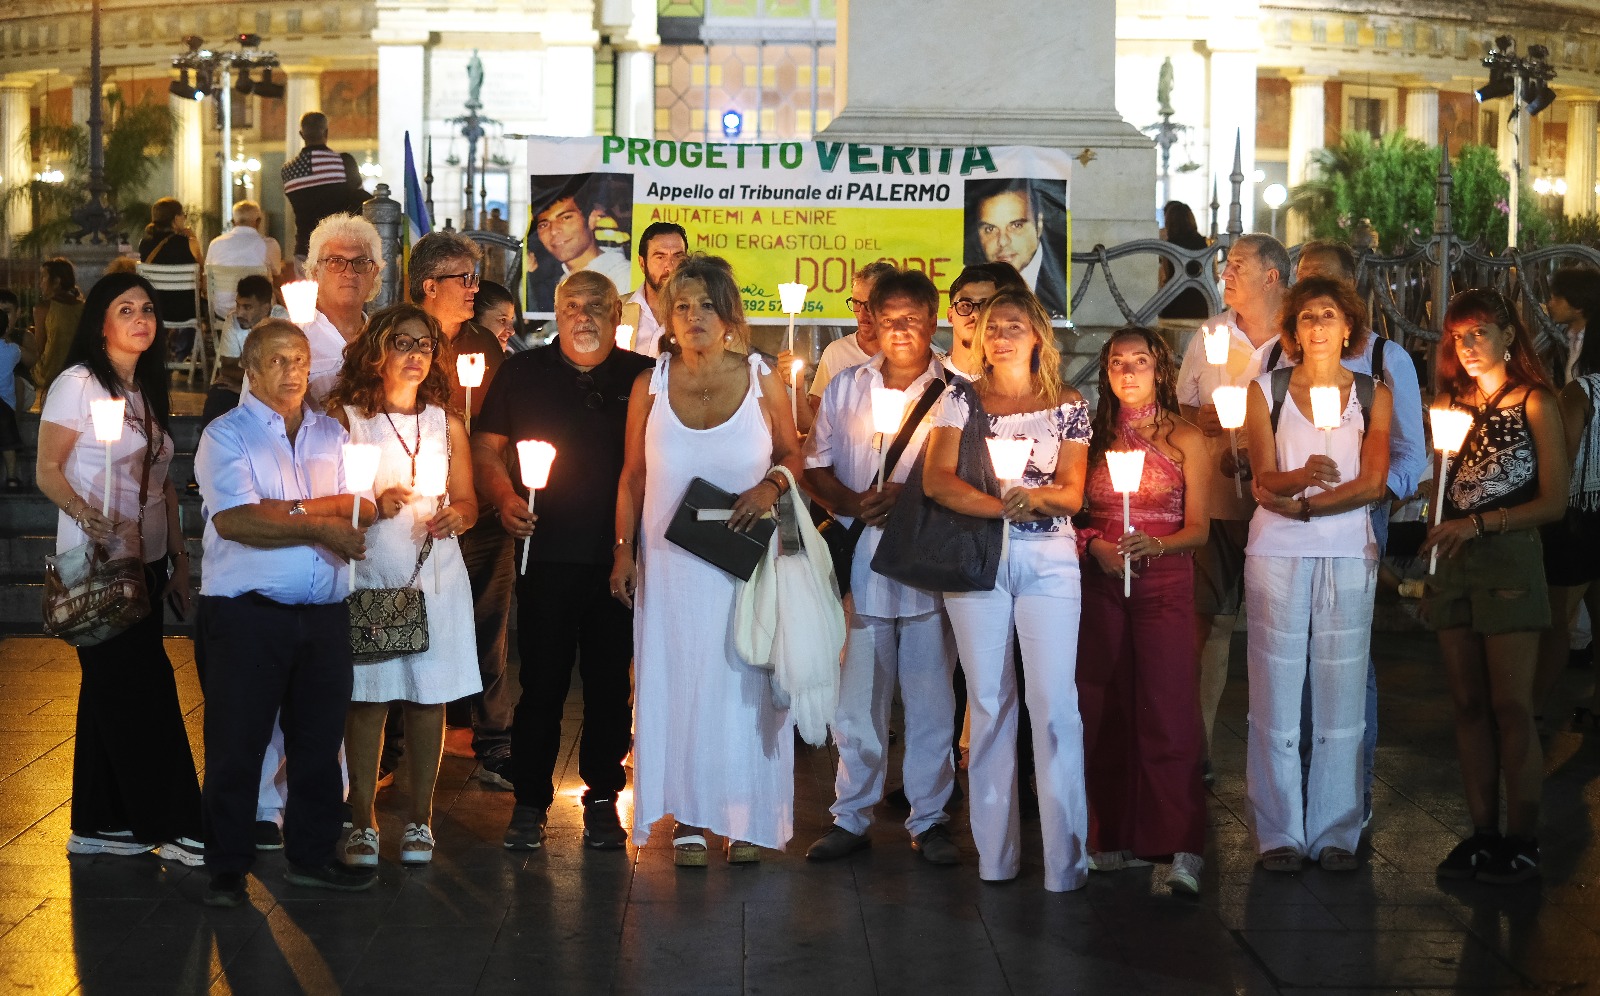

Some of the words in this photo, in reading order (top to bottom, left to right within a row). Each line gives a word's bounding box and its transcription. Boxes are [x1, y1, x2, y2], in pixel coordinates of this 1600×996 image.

[602, 135, 804, 170] PROGETTO
[647, 182, 714, 201] Appello
[719, 185, 735, 200] al
[740, 185, 822, 201] Tribunale
[826, 185, 843, 200] di
[847, 182, 951, 202] PALERMO
[651, 207, 744, 225] AIUTATEMI
[751, 209, 763, 225] A
[771, 209, 837, 226] LENIRE
[696, 233, 728, 249] MIO
[736, 234, 847, 251] ERGASTOLO
[854, 238, 882, 251] DEL
[743, 299, 766, 312] 392
